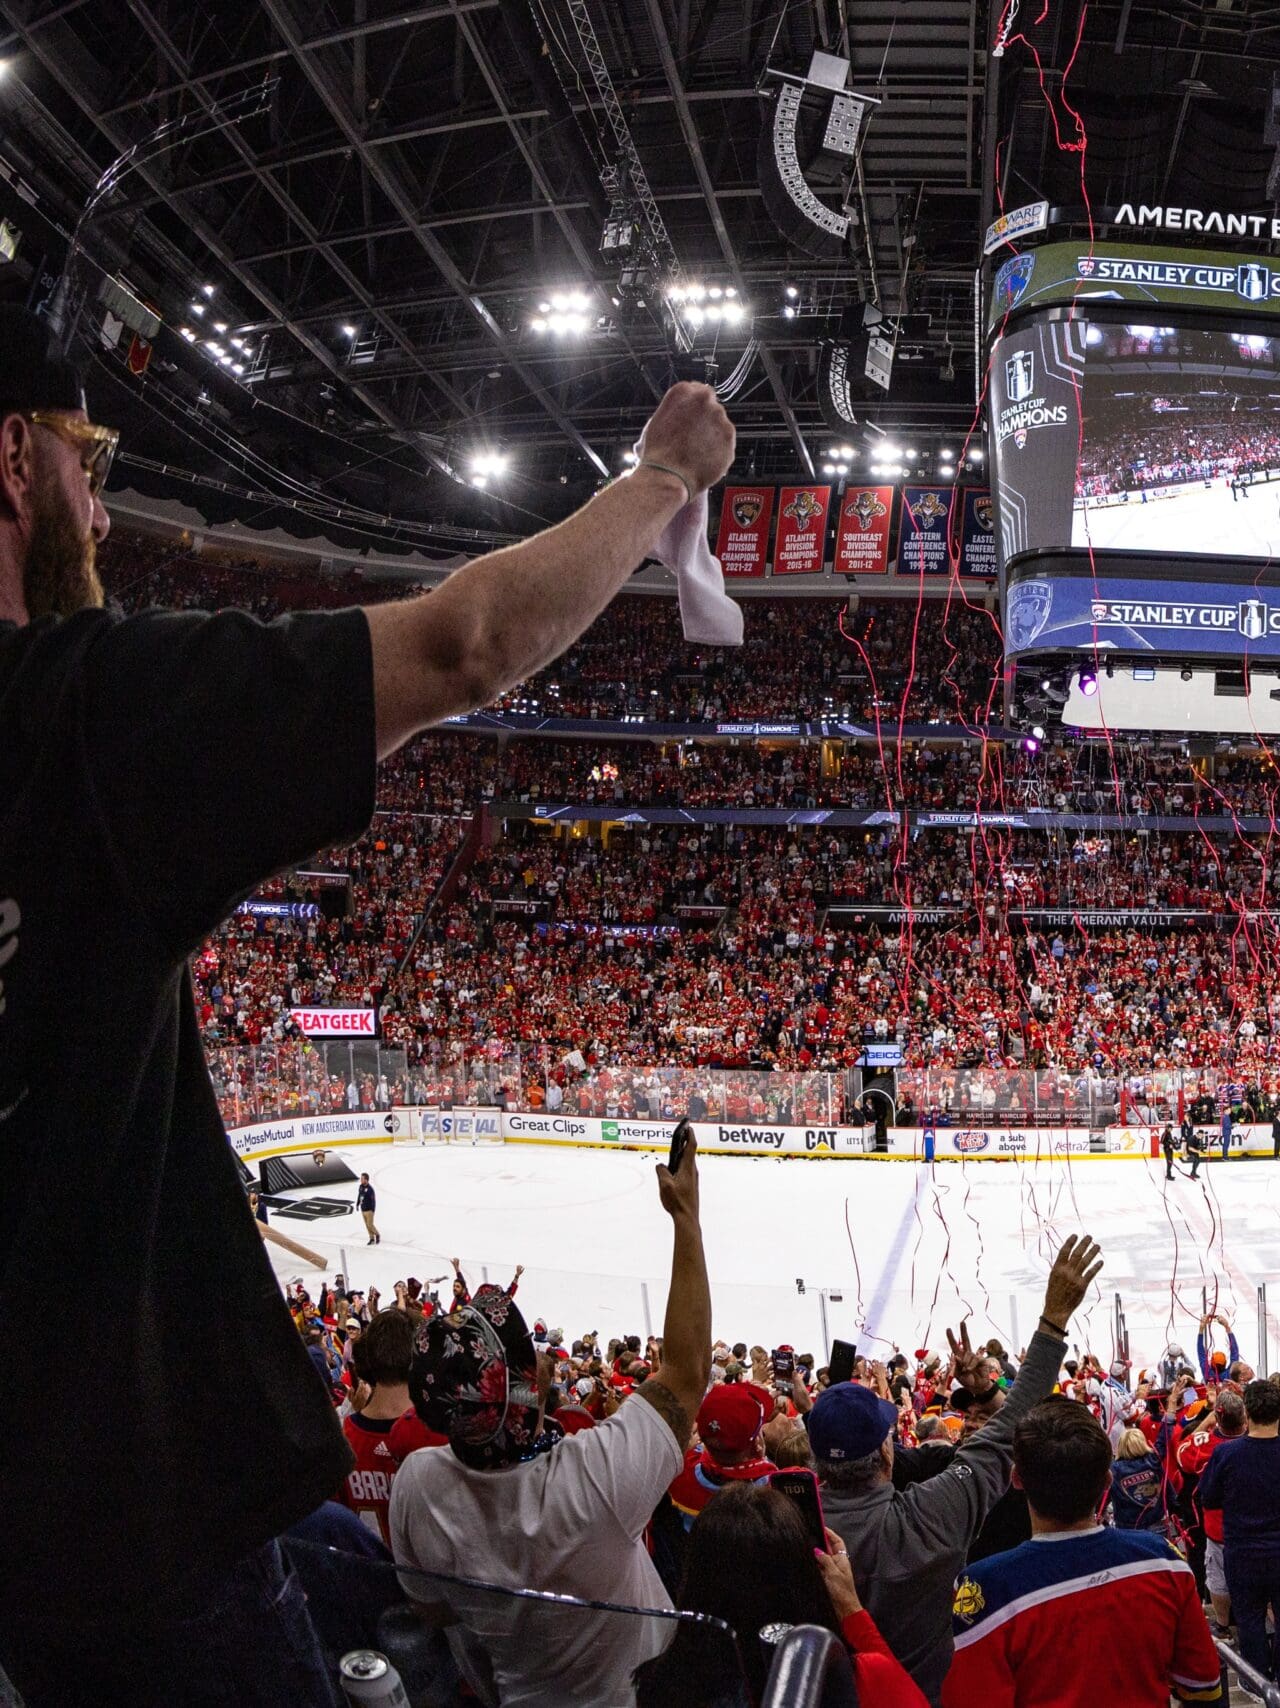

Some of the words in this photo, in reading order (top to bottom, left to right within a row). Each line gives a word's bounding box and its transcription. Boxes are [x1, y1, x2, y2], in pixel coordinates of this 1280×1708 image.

[1114, 203, 1266, 237] AMERANT
[1098, 261, 1190, 284] STANLEY
[1194, 269, 1235, 289] CUP
[727, 533, 759, 542] ATLANTIC
[785, 533, 817, 543] ATLANTIC
[843, 533, 882, 542] SOUTHEAST
[910, 532, 941, 541] EASTERN
[727, 543, 757, 551] DIVISION
[785, 542, 814, 551] DIVISION
[847, 542, 877, 550] DIVISION
[903, 541, 947, 551] CONFERENCE
[965, 544, 996, 553] CONFERE
[721, 553, 760, 562] CHAMPIONS
[779, 550, 818, 560] CHAMPIONS
[841, 550, 882, 559] CHAMPIONS
[965, 553, 997, 563] CHAMPIO
[725, 563, 752, 572] 2021-22
[1110, 604, 1194, 624] STANLEY
[1199, 610, 1236, 626] CUP
[888, 912, 945, 923] AMERANT
[1047, 915, 1067, 925] THE
[1070, 915, 1128, 926] AMERANT
[1131, 915, 1172, 926] VAULT
[294, 1012, 371, 1032] SEATGEEK
[302, 1124, 315, 1136] NEW
[315, 1121, 355, 1133] AMSTERDAM
[355, 1120, 376, 1131] VODKA
[509, 1116, 550, 1132] Great
[552, 1119, 586, 1136] Clips
[242, 1126, 295, 1147] MassMutual
[608, 1126, 673, 1139] enterpris
[719, 1127, 785, 1149] betway
[805, 1130, 837, 1151] CAT
[1009, 1134, 1024, 1142] sub
[999, 1143, 1026, 1151] above
[349, 1470, 396, 1501] BAR
